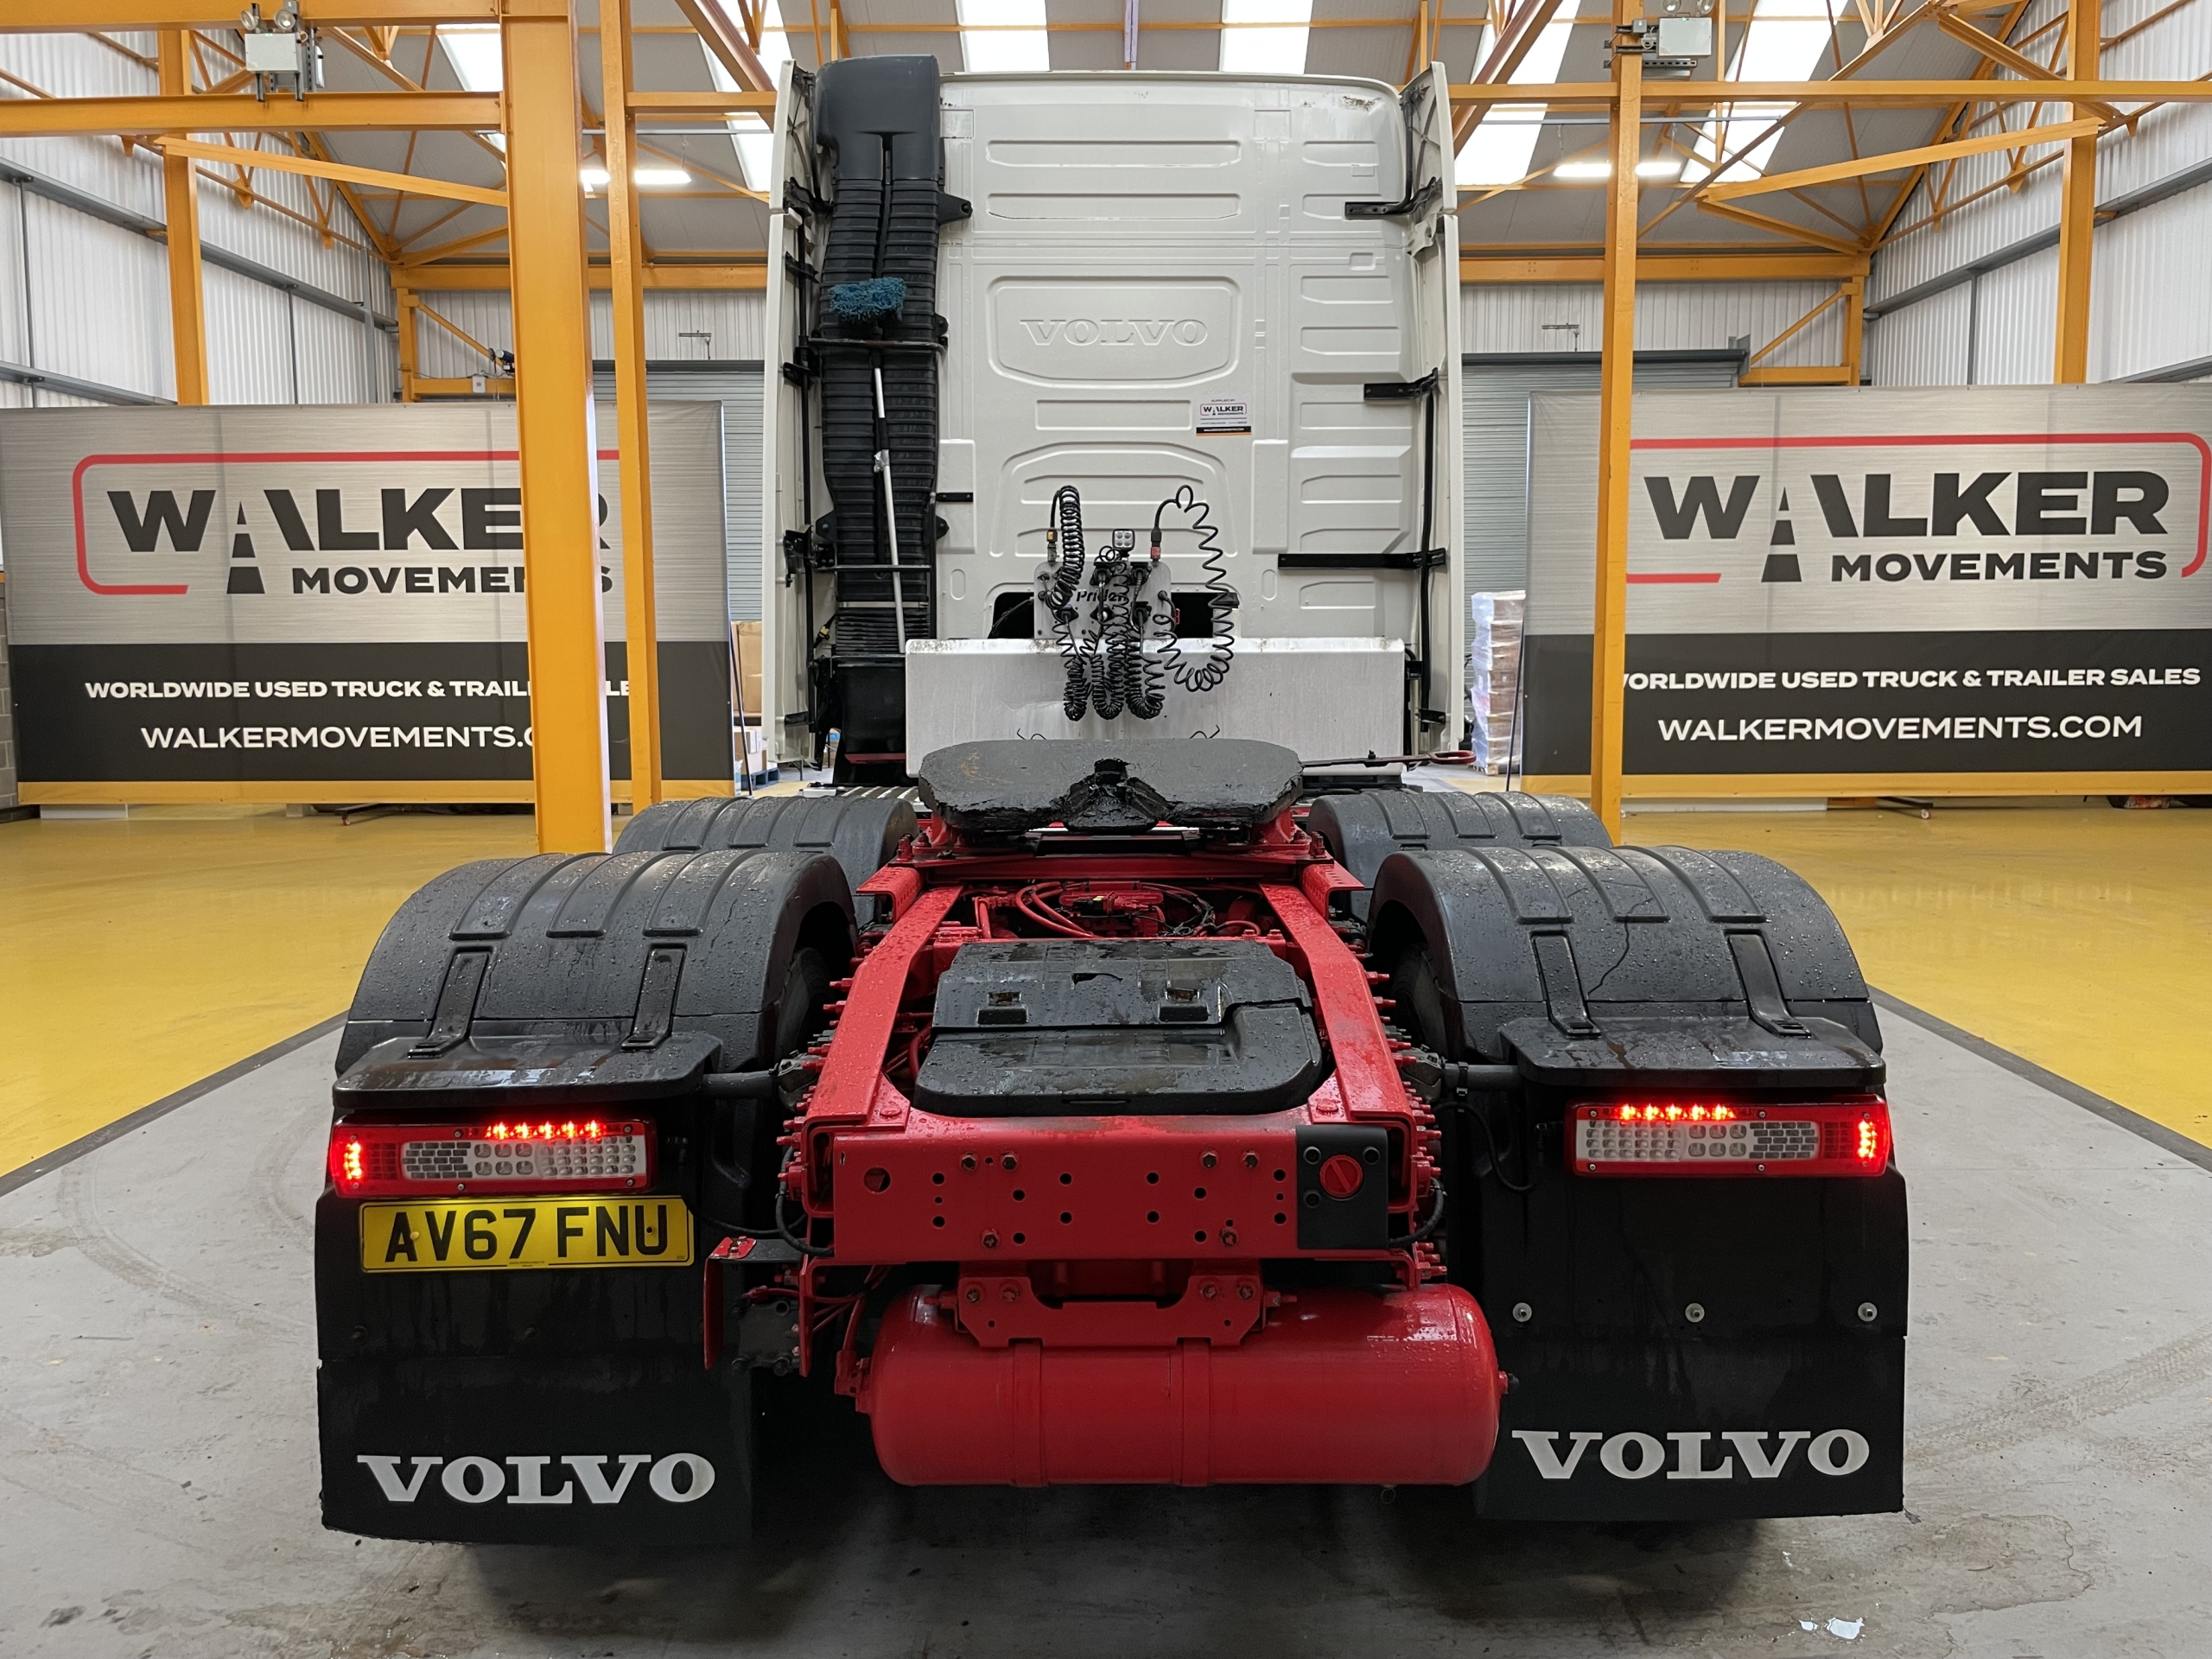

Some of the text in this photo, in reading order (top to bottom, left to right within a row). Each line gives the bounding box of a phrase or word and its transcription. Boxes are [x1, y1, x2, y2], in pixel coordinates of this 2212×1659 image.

[1020, 319, 1208, 346] VOLVO
[1203, 405, 1243, 416] WALKER
[1643, 471, 2170, 582] WALKER
[107, 488, 611, 594] WALKE
[292, 566, 613, 594] MOVEME
[1831, 550, 2167, 582] MOVEMENTS
[85, 680, 531, 698] WORLDWIDE USED TRUCK & TRAIL
[1624, 668, 2201, 690] ORLDWIDE USED TRUCK & TRAILER SALES
[141, 727, 533, 748] WALKERMOVEMENTS.
[1657, 715, 2142, 741] WALKERMOVEMENTS.COM
[385, 1205, 667, 1263] AV67 FNU
[1511, 1428, 1870, 1479] VOLVO
[357, 1452, 715, 1503] VOLVO
